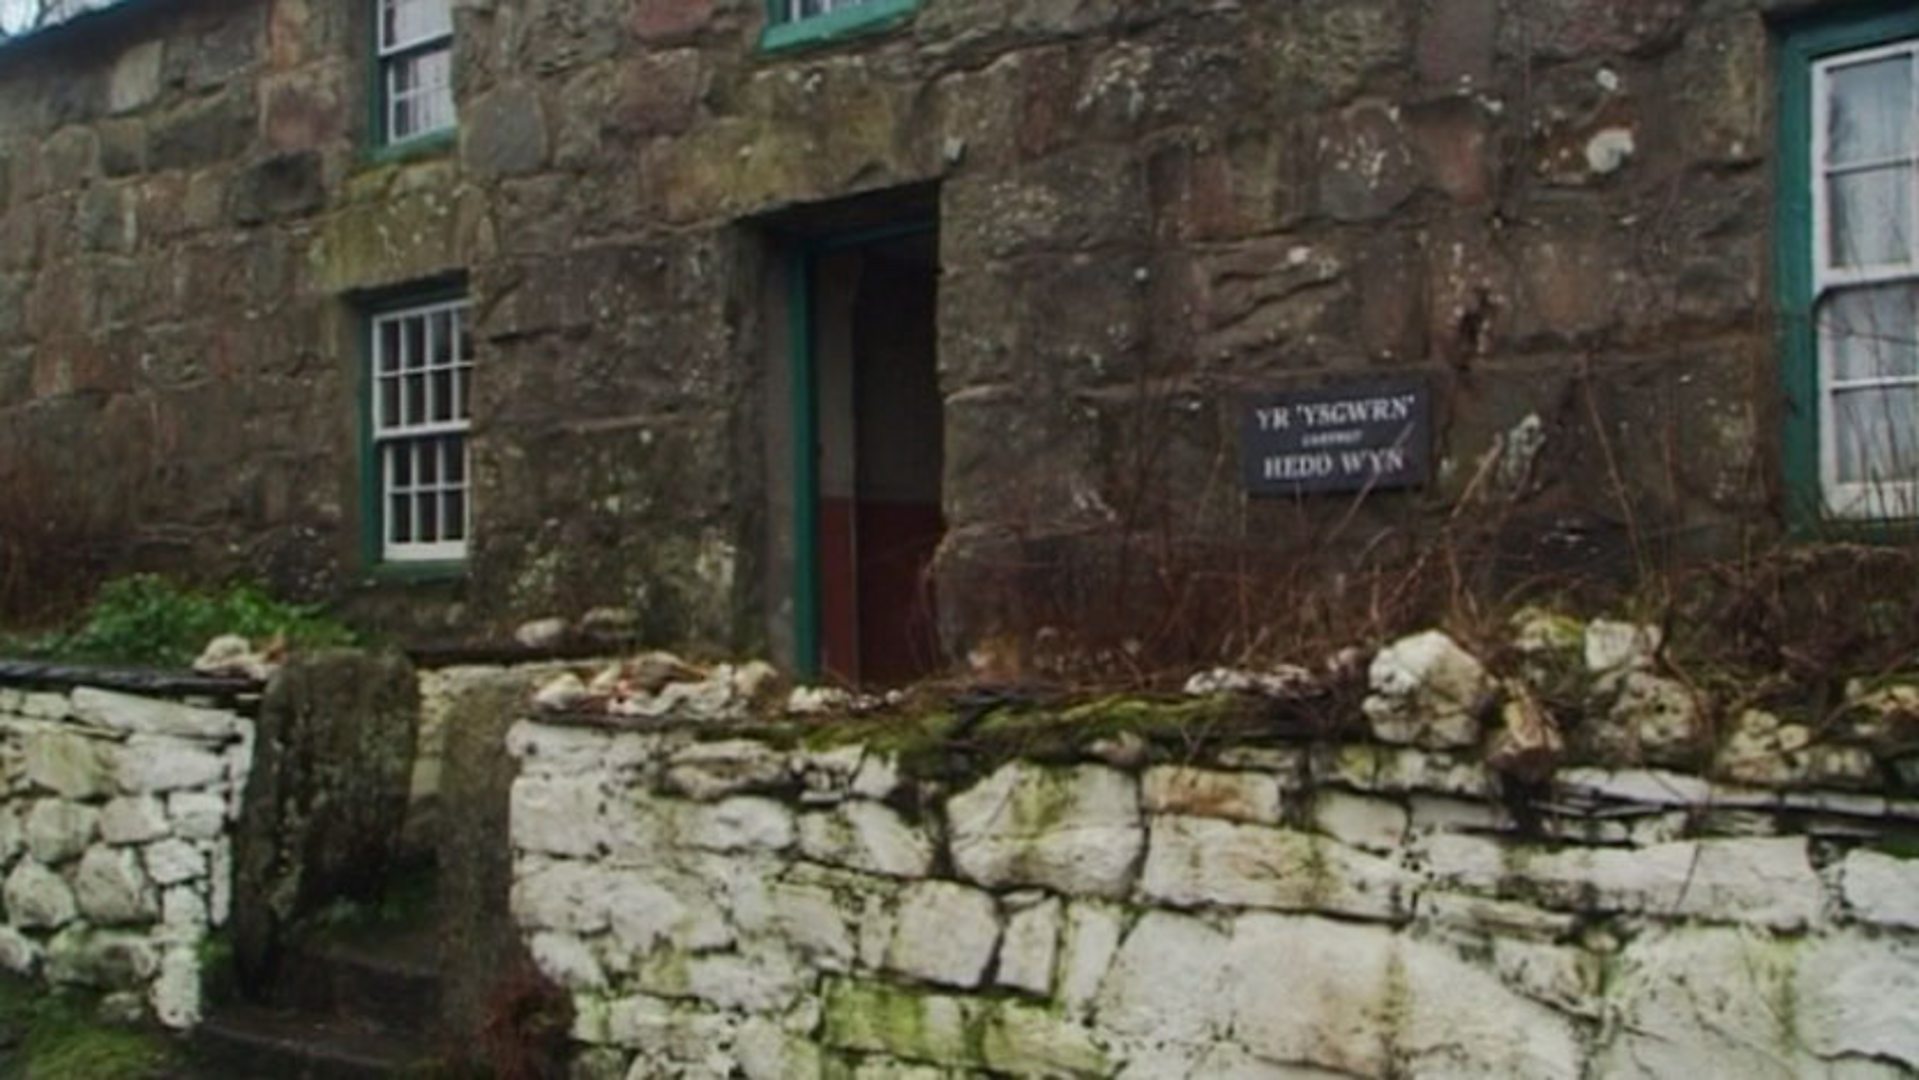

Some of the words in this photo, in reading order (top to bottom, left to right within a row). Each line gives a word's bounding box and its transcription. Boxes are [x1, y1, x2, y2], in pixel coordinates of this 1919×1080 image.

[1256, 408, 1290, 430] YR
[1264, 452, 1333, 479] HEDD
[1341, 449, 1403, 475] WYN
